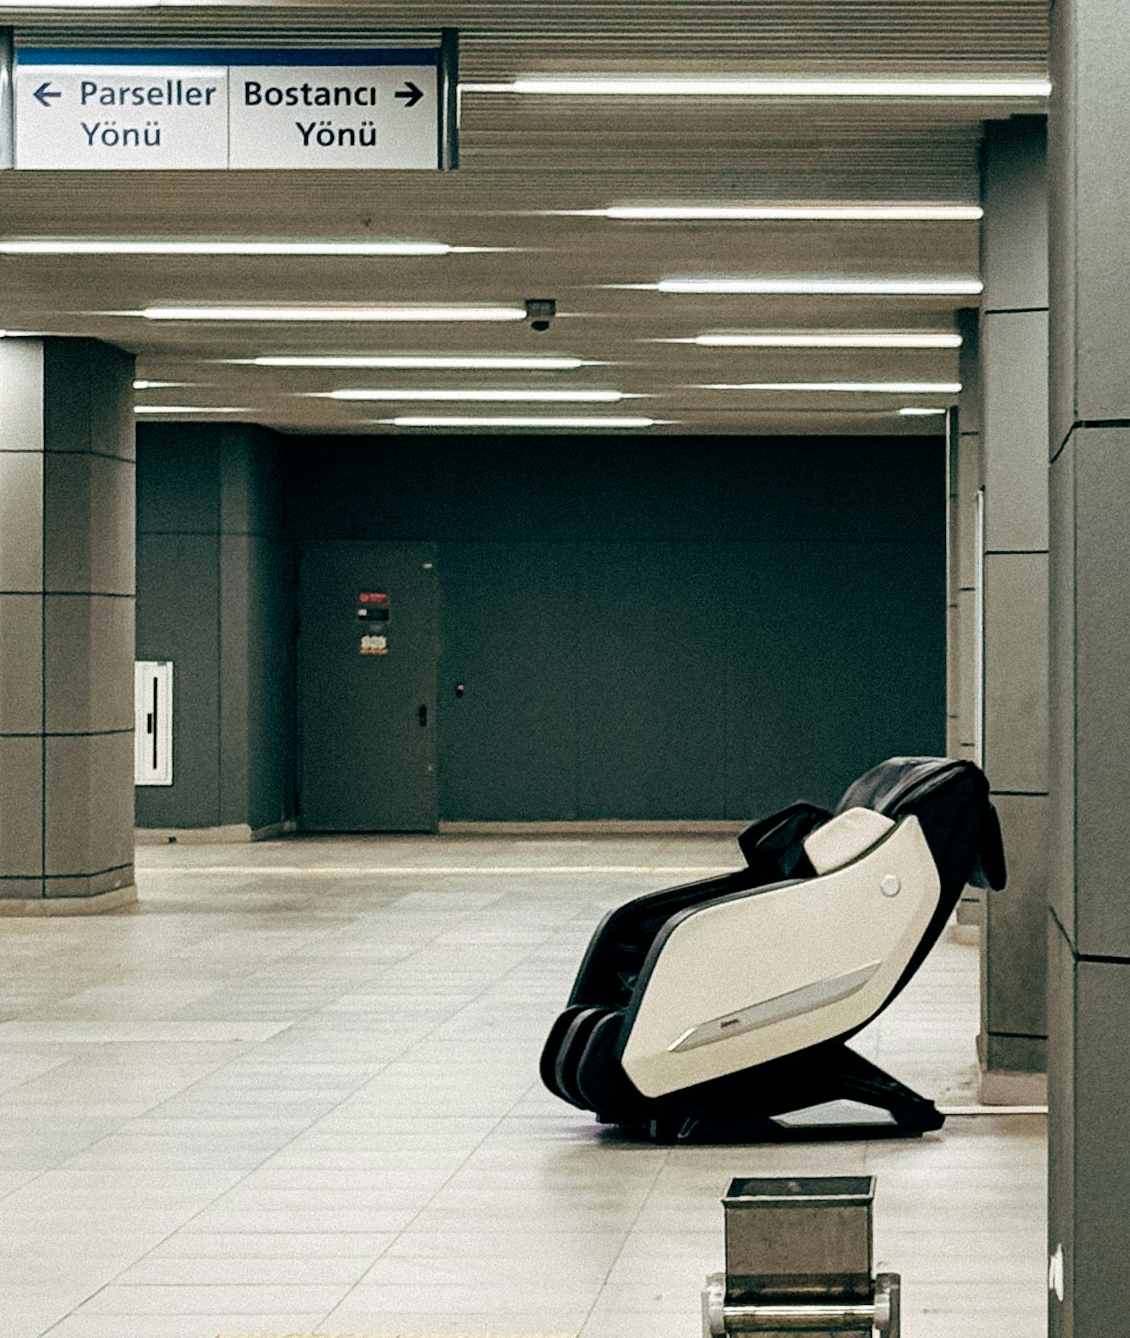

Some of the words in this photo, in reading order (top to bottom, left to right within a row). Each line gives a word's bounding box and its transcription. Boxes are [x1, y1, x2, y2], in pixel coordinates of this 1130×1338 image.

[81, 79, 217, 107] Parseller
[244, 80, 377, 107] Bostancı
[81, 121, 161, 147] Yönü
[295, 120, 377, 147] Yönü
